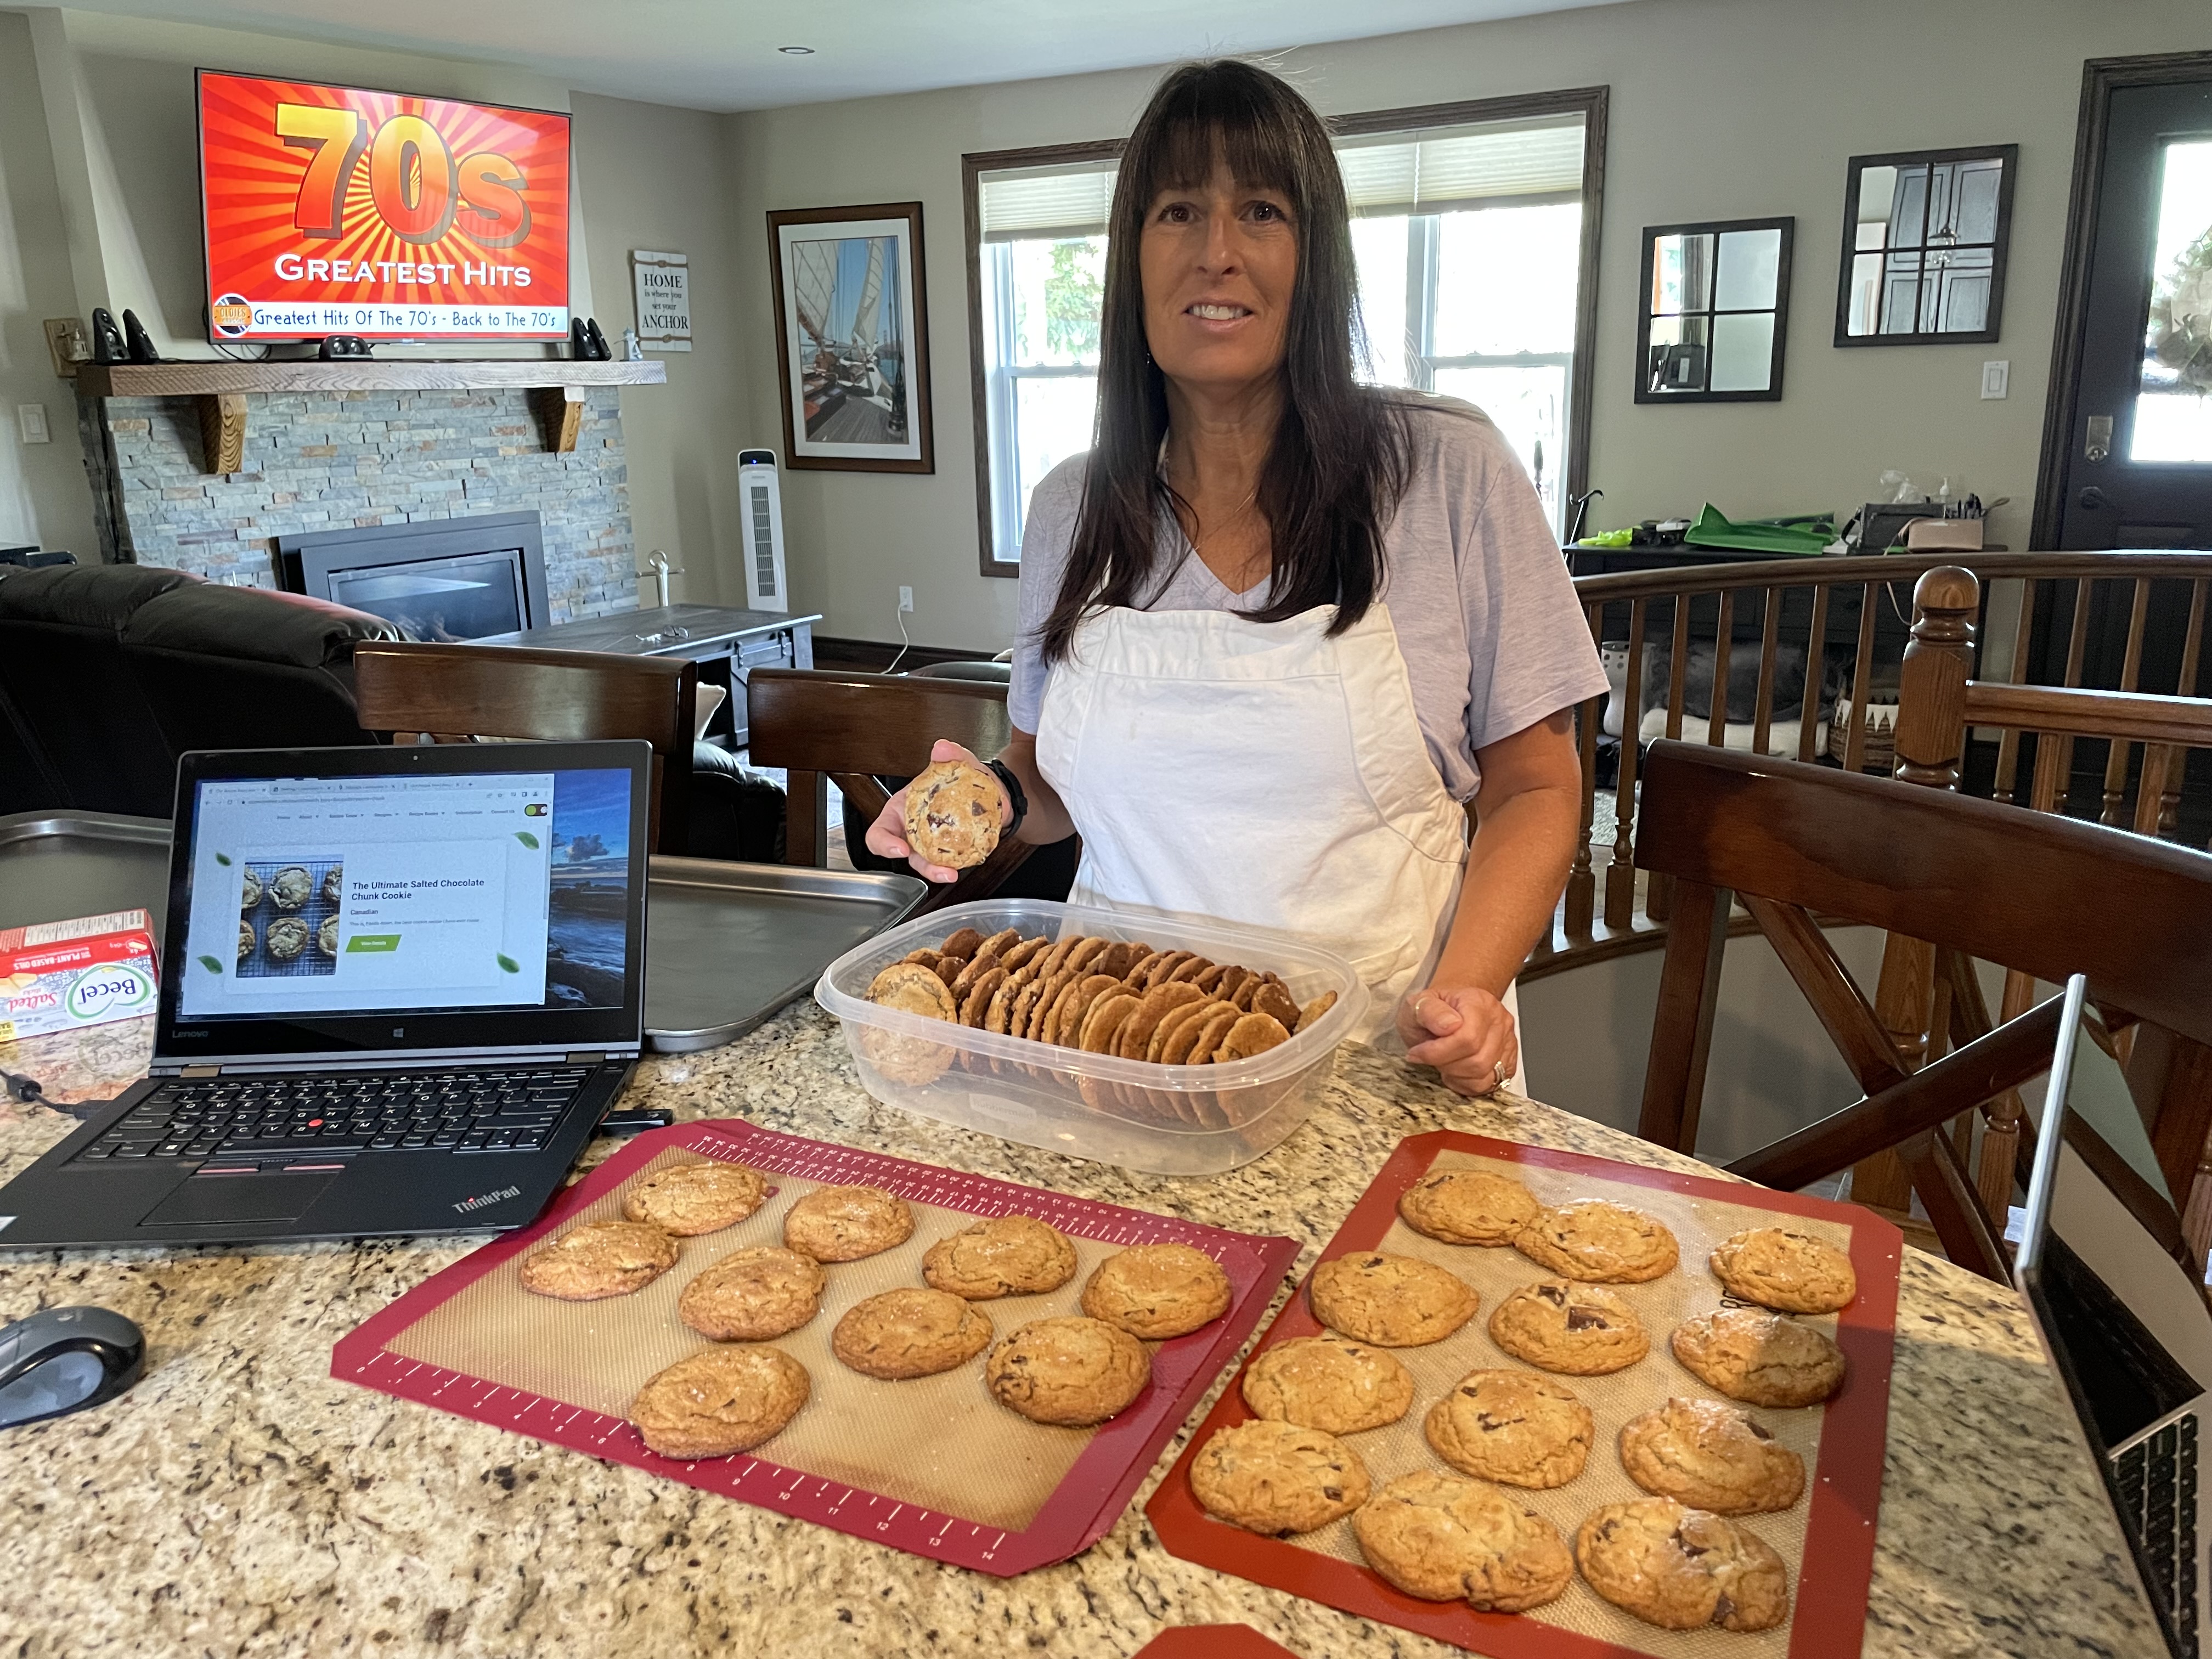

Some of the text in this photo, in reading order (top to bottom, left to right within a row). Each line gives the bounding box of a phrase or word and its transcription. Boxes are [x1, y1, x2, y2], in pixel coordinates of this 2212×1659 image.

[276, 103, 530, 247] 70s
[644, 274, 682, 288] HOME
[651, 290, 669, 298] where
[671, 292, 681, 300] you
[220, 308, 246, 317] OLDIES
[662, 304, 676, 312] your
[255, 309, 317, 325] Greatest
[324, 309, 348, 325] Hits
[356, 311, 373, 325] Of
[379, 311, 403, 325] The
[409, 311, 437, 325] 70's
[453, 311, 482, 326] Back
[489, 313, 500, 326] to
[505, 312, 526, 326] The
[531, 312, 556, 327] 70's
[642, 314, 688, 329] ANCHOR
[371, 881, 408, 889] Ultimate
[441, 879, 484, 887] Chocolate
[352, 891, 412, 900] Chunk Cookie
[13, 961, 31, 970] OILS
[31, 952, 81, 967] PLANT-BASED
[81, 979, 136, 1003] Becel
[9, 992, 57, 1012] Salted
[452, 1186, 521, 1213] ThinkPad
[778, 1492, 791, 1500] 10
[828, 1507, 839, 1515] 11
[877, 1521, 889, 1531] 12
[929, 1537, 941, 1546] 13
[982, 1551, 994, 1560] 14
